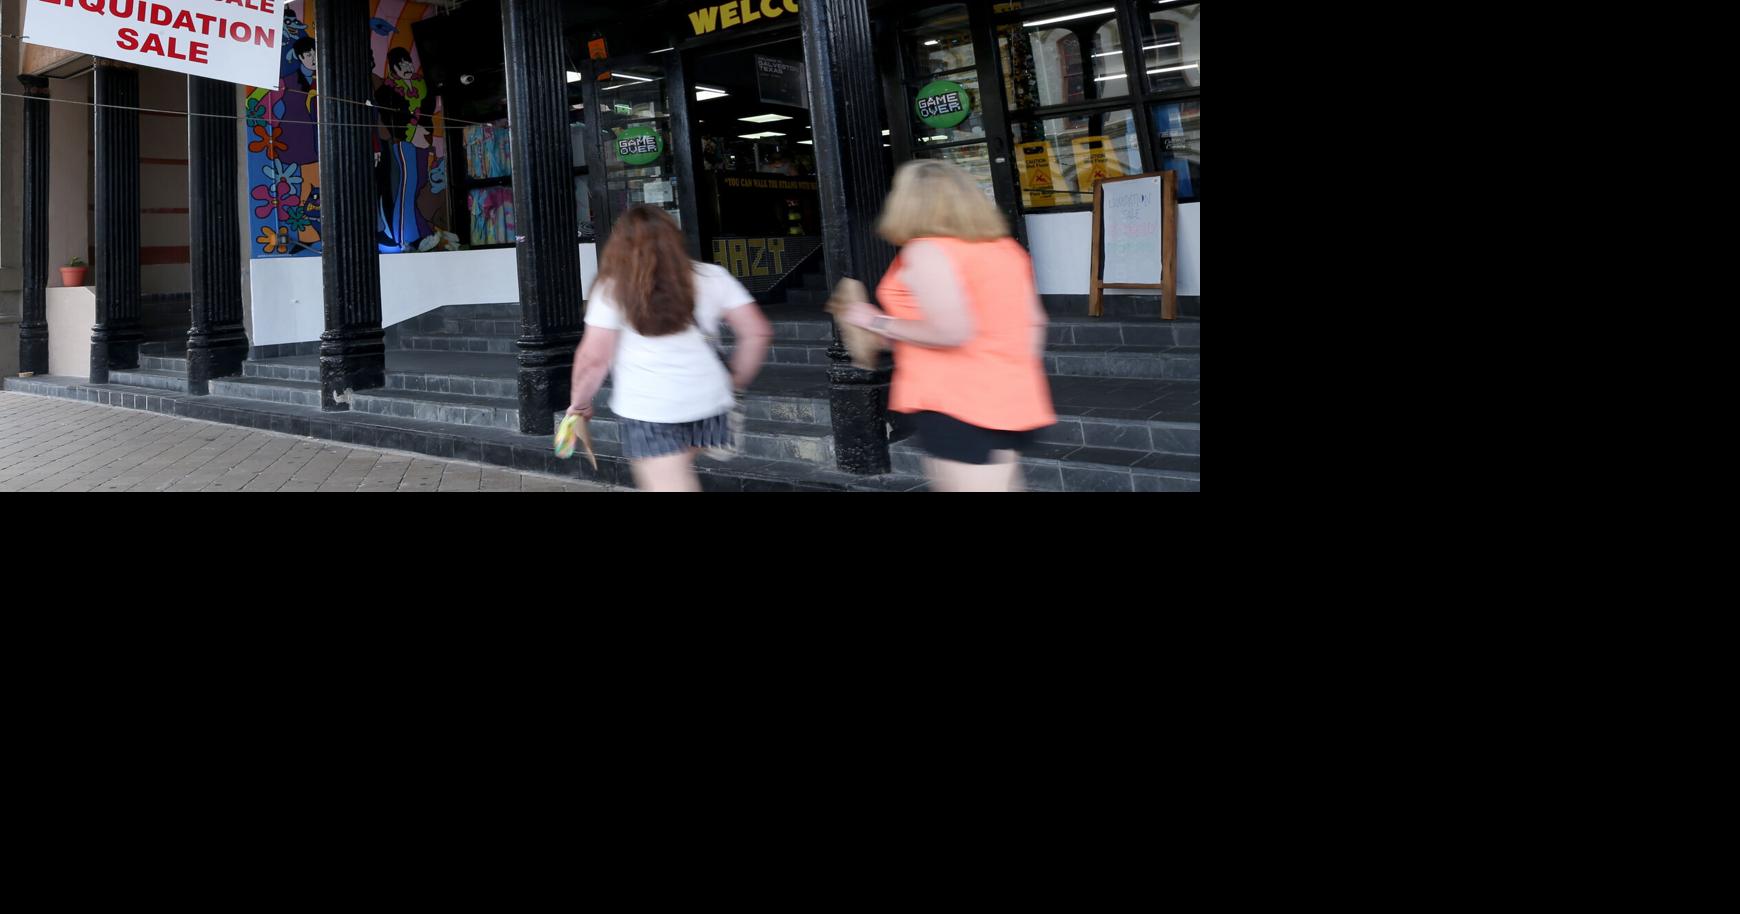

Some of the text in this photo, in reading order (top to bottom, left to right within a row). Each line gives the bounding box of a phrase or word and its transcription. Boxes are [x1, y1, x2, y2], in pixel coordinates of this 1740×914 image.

[38, 0, 275, 48] QUIDATION
[116, 27, 209, 64] SALE
[918, 92, 958, 109] GAME
[921, 102, 960, 117] OVER
[619, 135, 656, 148] GAME
[620, 144, 657, 155] OVER
